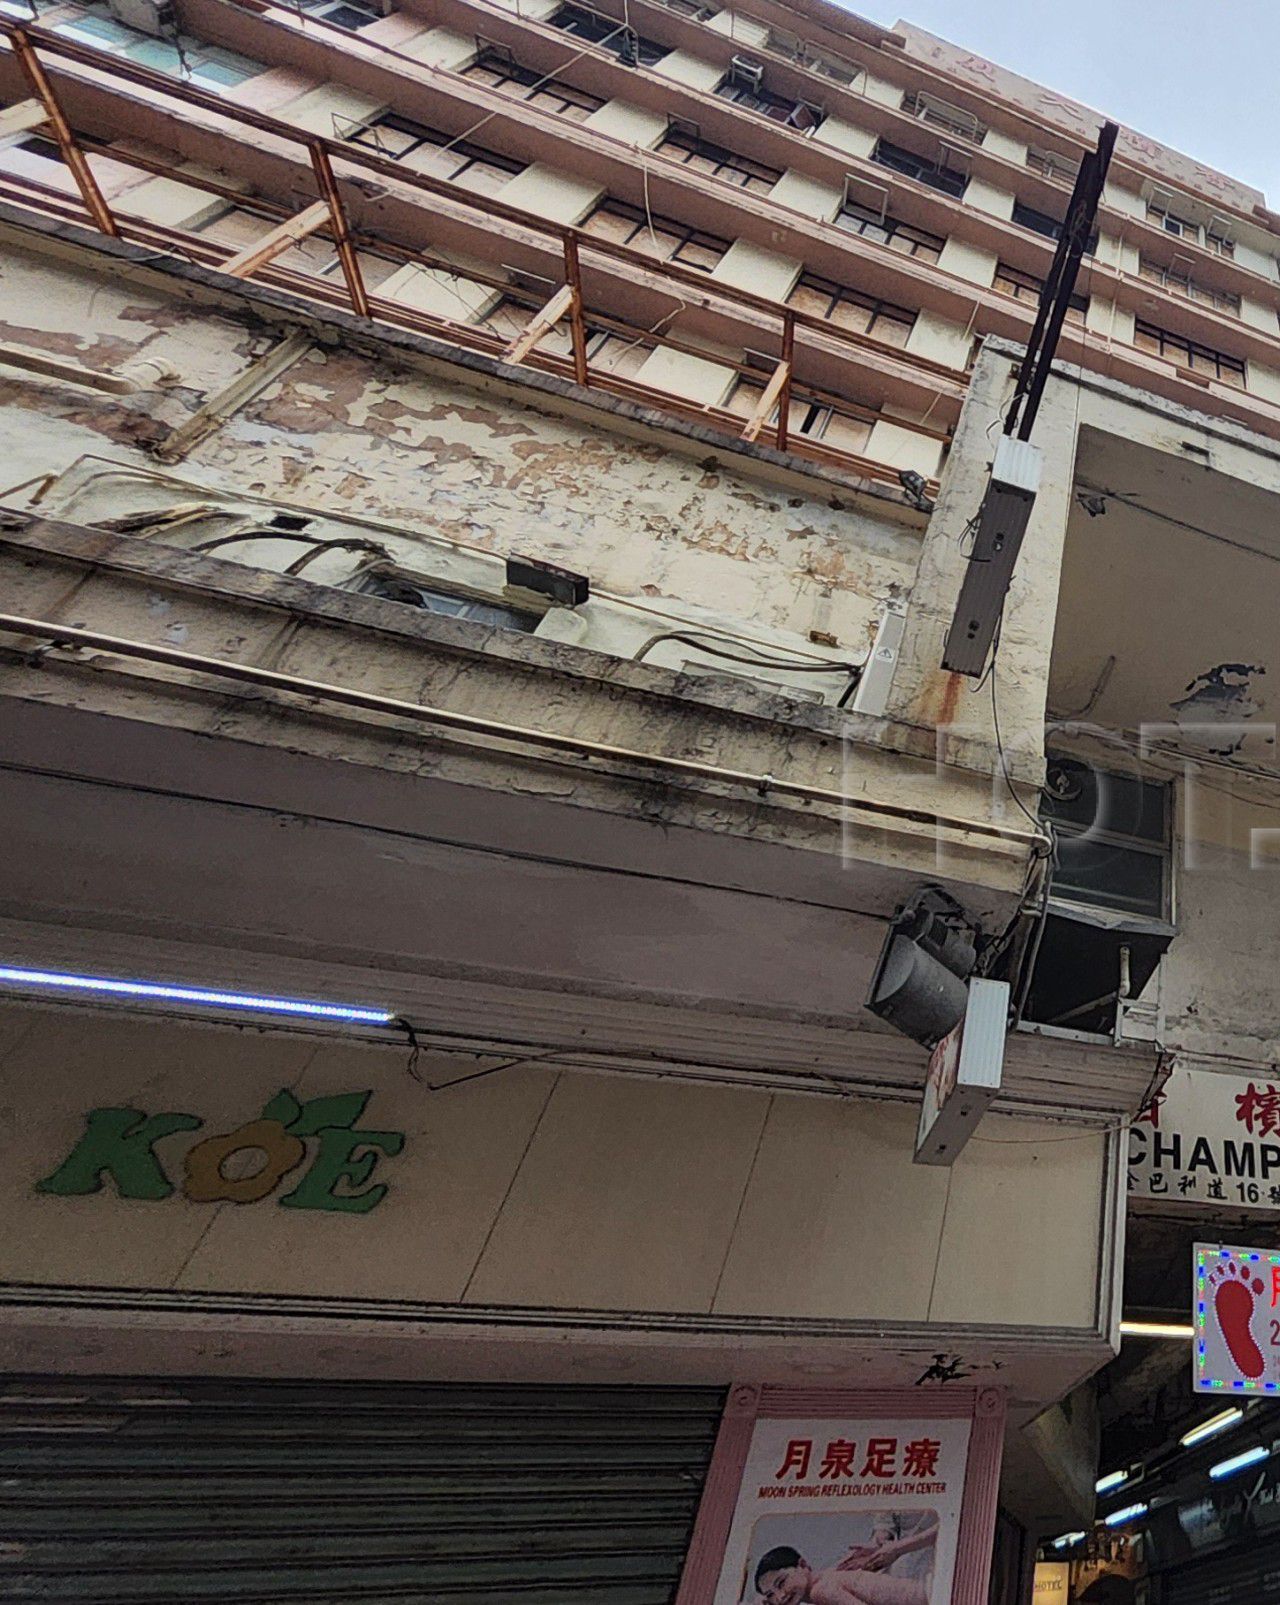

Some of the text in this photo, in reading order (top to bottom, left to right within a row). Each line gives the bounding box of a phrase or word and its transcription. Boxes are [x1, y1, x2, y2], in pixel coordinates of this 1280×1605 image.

[35, 1089, 405, 1213] KOE
[775, 1438, 941, 1480] 月泉足療
[758, 1482, 947, 1499] MOON SPRING REFLEXOLOGY HEALTH CENTER
